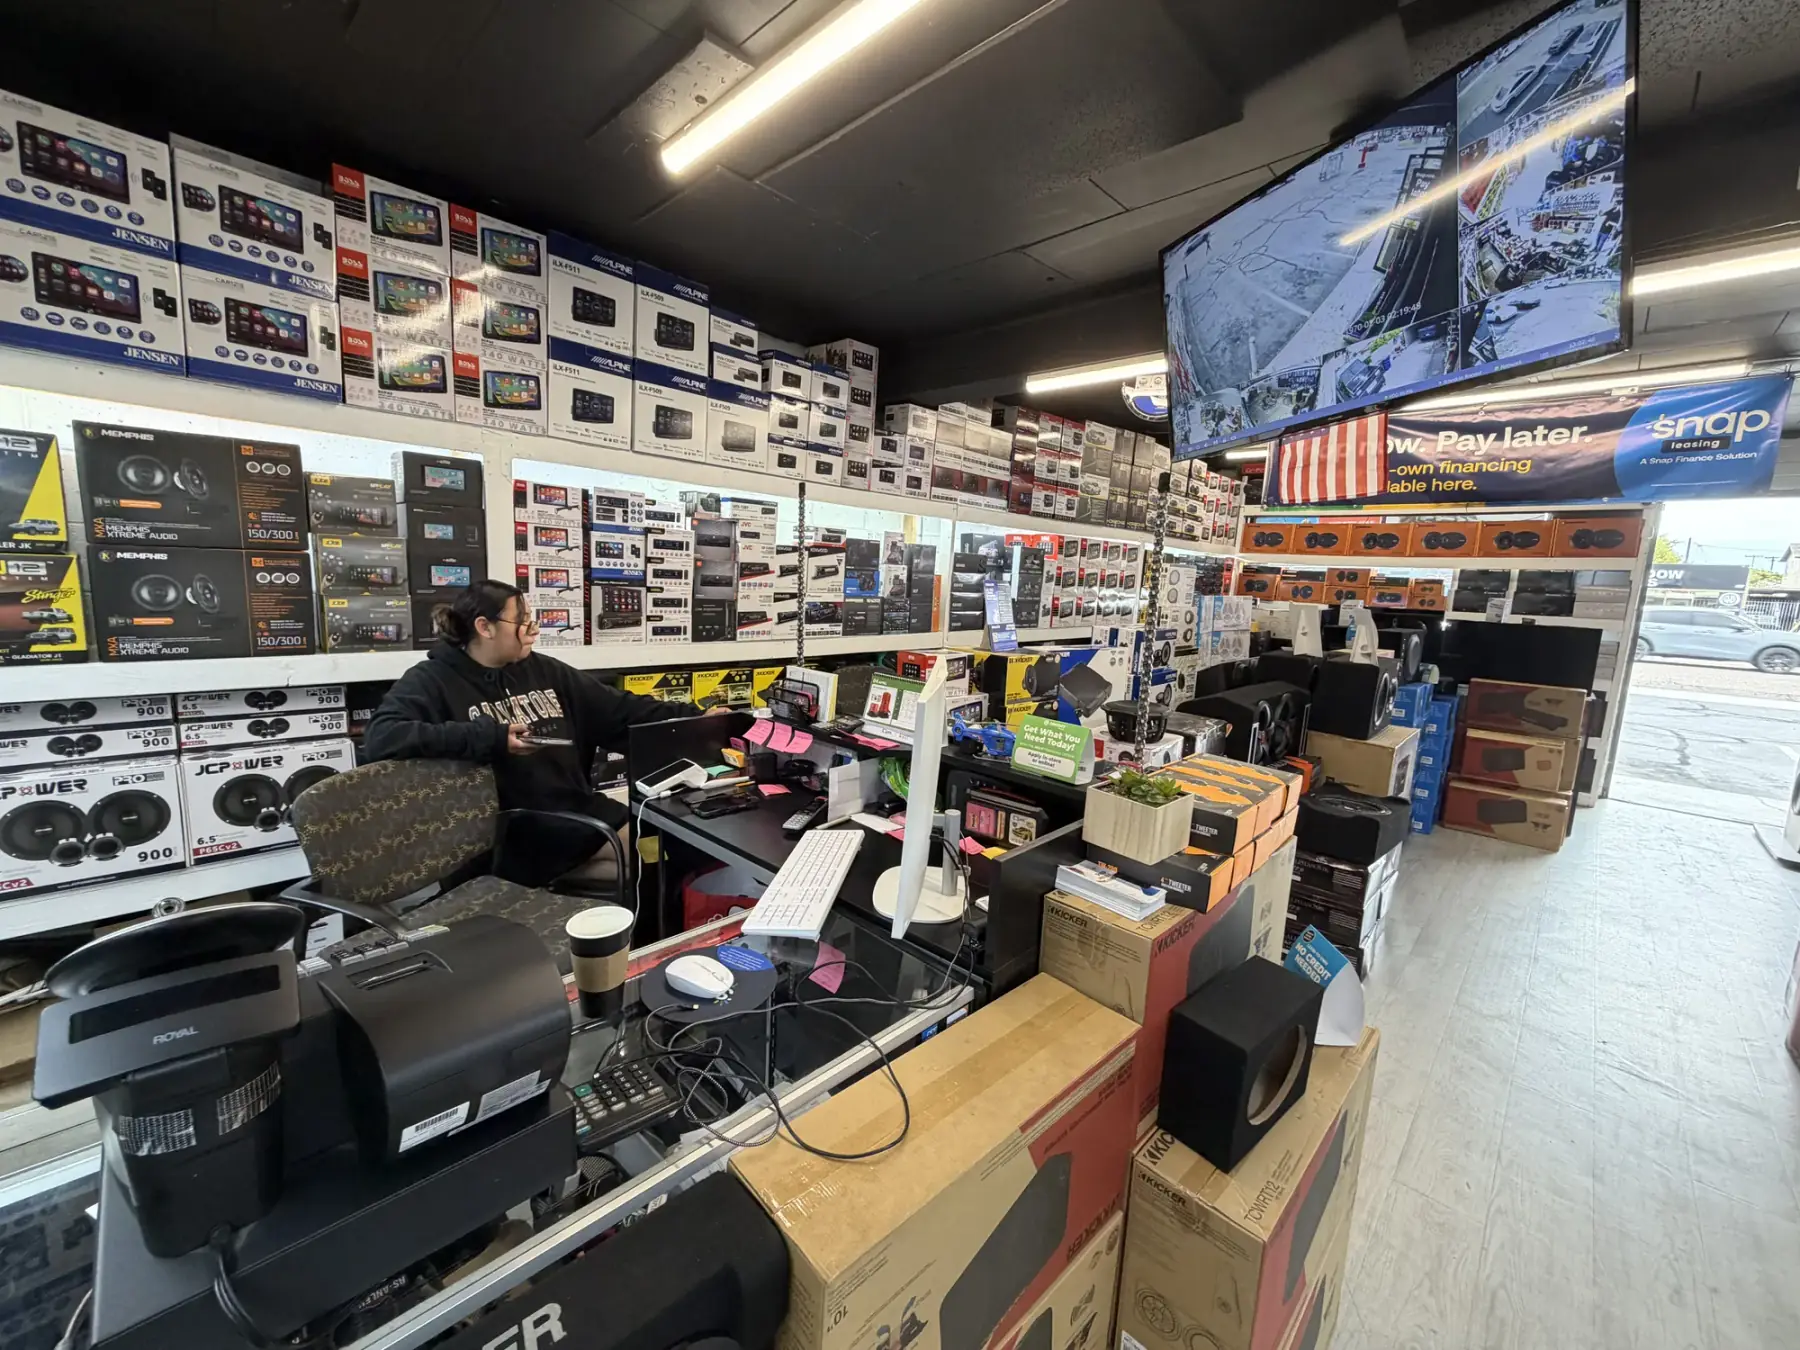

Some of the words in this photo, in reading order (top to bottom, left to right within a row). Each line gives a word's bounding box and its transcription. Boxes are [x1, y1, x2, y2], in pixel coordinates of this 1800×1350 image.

[112, 228, 170, 251] JENSEN
[288, 274, 334, 296] JENSEN
[124, 346, 180, 366] JENSEN
[552, 364, 580, 377] iLX-F511
[293, 377, 338, 395] JENSEN
[410, 405, 455, 420] WATTS
[508, 422, 547, 435] WATTS
[1651, 409, 1771, 443] snap
[101, 428, 155, 441] MEMPHIS
[1386, 436, 1426, 454] ow.
[1436, 429, 1498, 456] Pay
[1503, 424, 1593, 448] later.
[1671, 438, 1720, 449] leasing
[1439, 457, 1532, 474] financing
[1649, 456, 1673, 465] Snap
[1675, 454, 1714, 463] Finance
[1715, 451, 1758, 461] Solution
[1431, 477, 1478, 493] here.
[93, 517, 105, 538] MXA
[106, 524, 151, 534] MEMPHIS
[247, 528, 294, 541] 150/300
[107, 530, 146, 540] XTREME
[149, 531, 179, 541] AUDIO
[18, 542, 32, 550] JK
[116, 551, 169, 561] MEMPHIS
[21, 587, 76, 604] Stinger
[108, 636, 118, 657] MXA
[119, 641, 163, 650] MEMPHIS
[256, 635, 302, 647] 150/300
[119, 647, 159, 656] XTREME
[161, 646, 190, 655] AUDIO
[631, 675, 654, 683] KICKER
[306, 688, 329, 697] PRO
[318, 695, 340, 705] 900
[121, 698, 151, 708] PRO
[137, 705, 165, 717] 900
[182, 703, 198, 711] 6.5
[184, 721, 234, 733] JCPOWER
[309, 715, 332, 724] PRO
[320, 721, 343, 731] 900
[127, 729, 157, 740] PRO
[142, 737, 170, 748] 900
[185, 732, 201, 741] 6.5
[1023, 724, 1038, 734] Get
[1040, 727, 1064, 740] What
[1065, 734, 1081, 744] You
[1024, 732, 1046, 745] Need
[1047, 738, 1076, 751] Today!
[302, 751, 329, 763] PRO
[1027, 751, 1042, 760] Apply
[195, 755, 284, 777] JCPOWER
[1038, 760, 1055, 769] online!
[113, 773, 147, 787] PRO
[0, 778, 88, 800] POWER
[1195, 823, 1219, 836] TWEETER
[137, 847, 173, 863] 900
[199, 842, 238, 856] P65Cv2
[1169, 878, 1192, 893] TWEETER
[1053, 908, 1088, 928] KICKER
[1159, 919, 1196, 952] KICKER
[1294, 941, 1308, 956] NO
[1304, 951, 1332, 981] CREDIT
[1293, 954, 1321, 984] NEEDED
[153, 1026, 199, 1045] ROYAL
[1149, 1131, 1176, 1166] KIC
[1143, 1176, 1187, 1208] KICKER
[1243, 1179, 1281, 1222] TCWRT12
